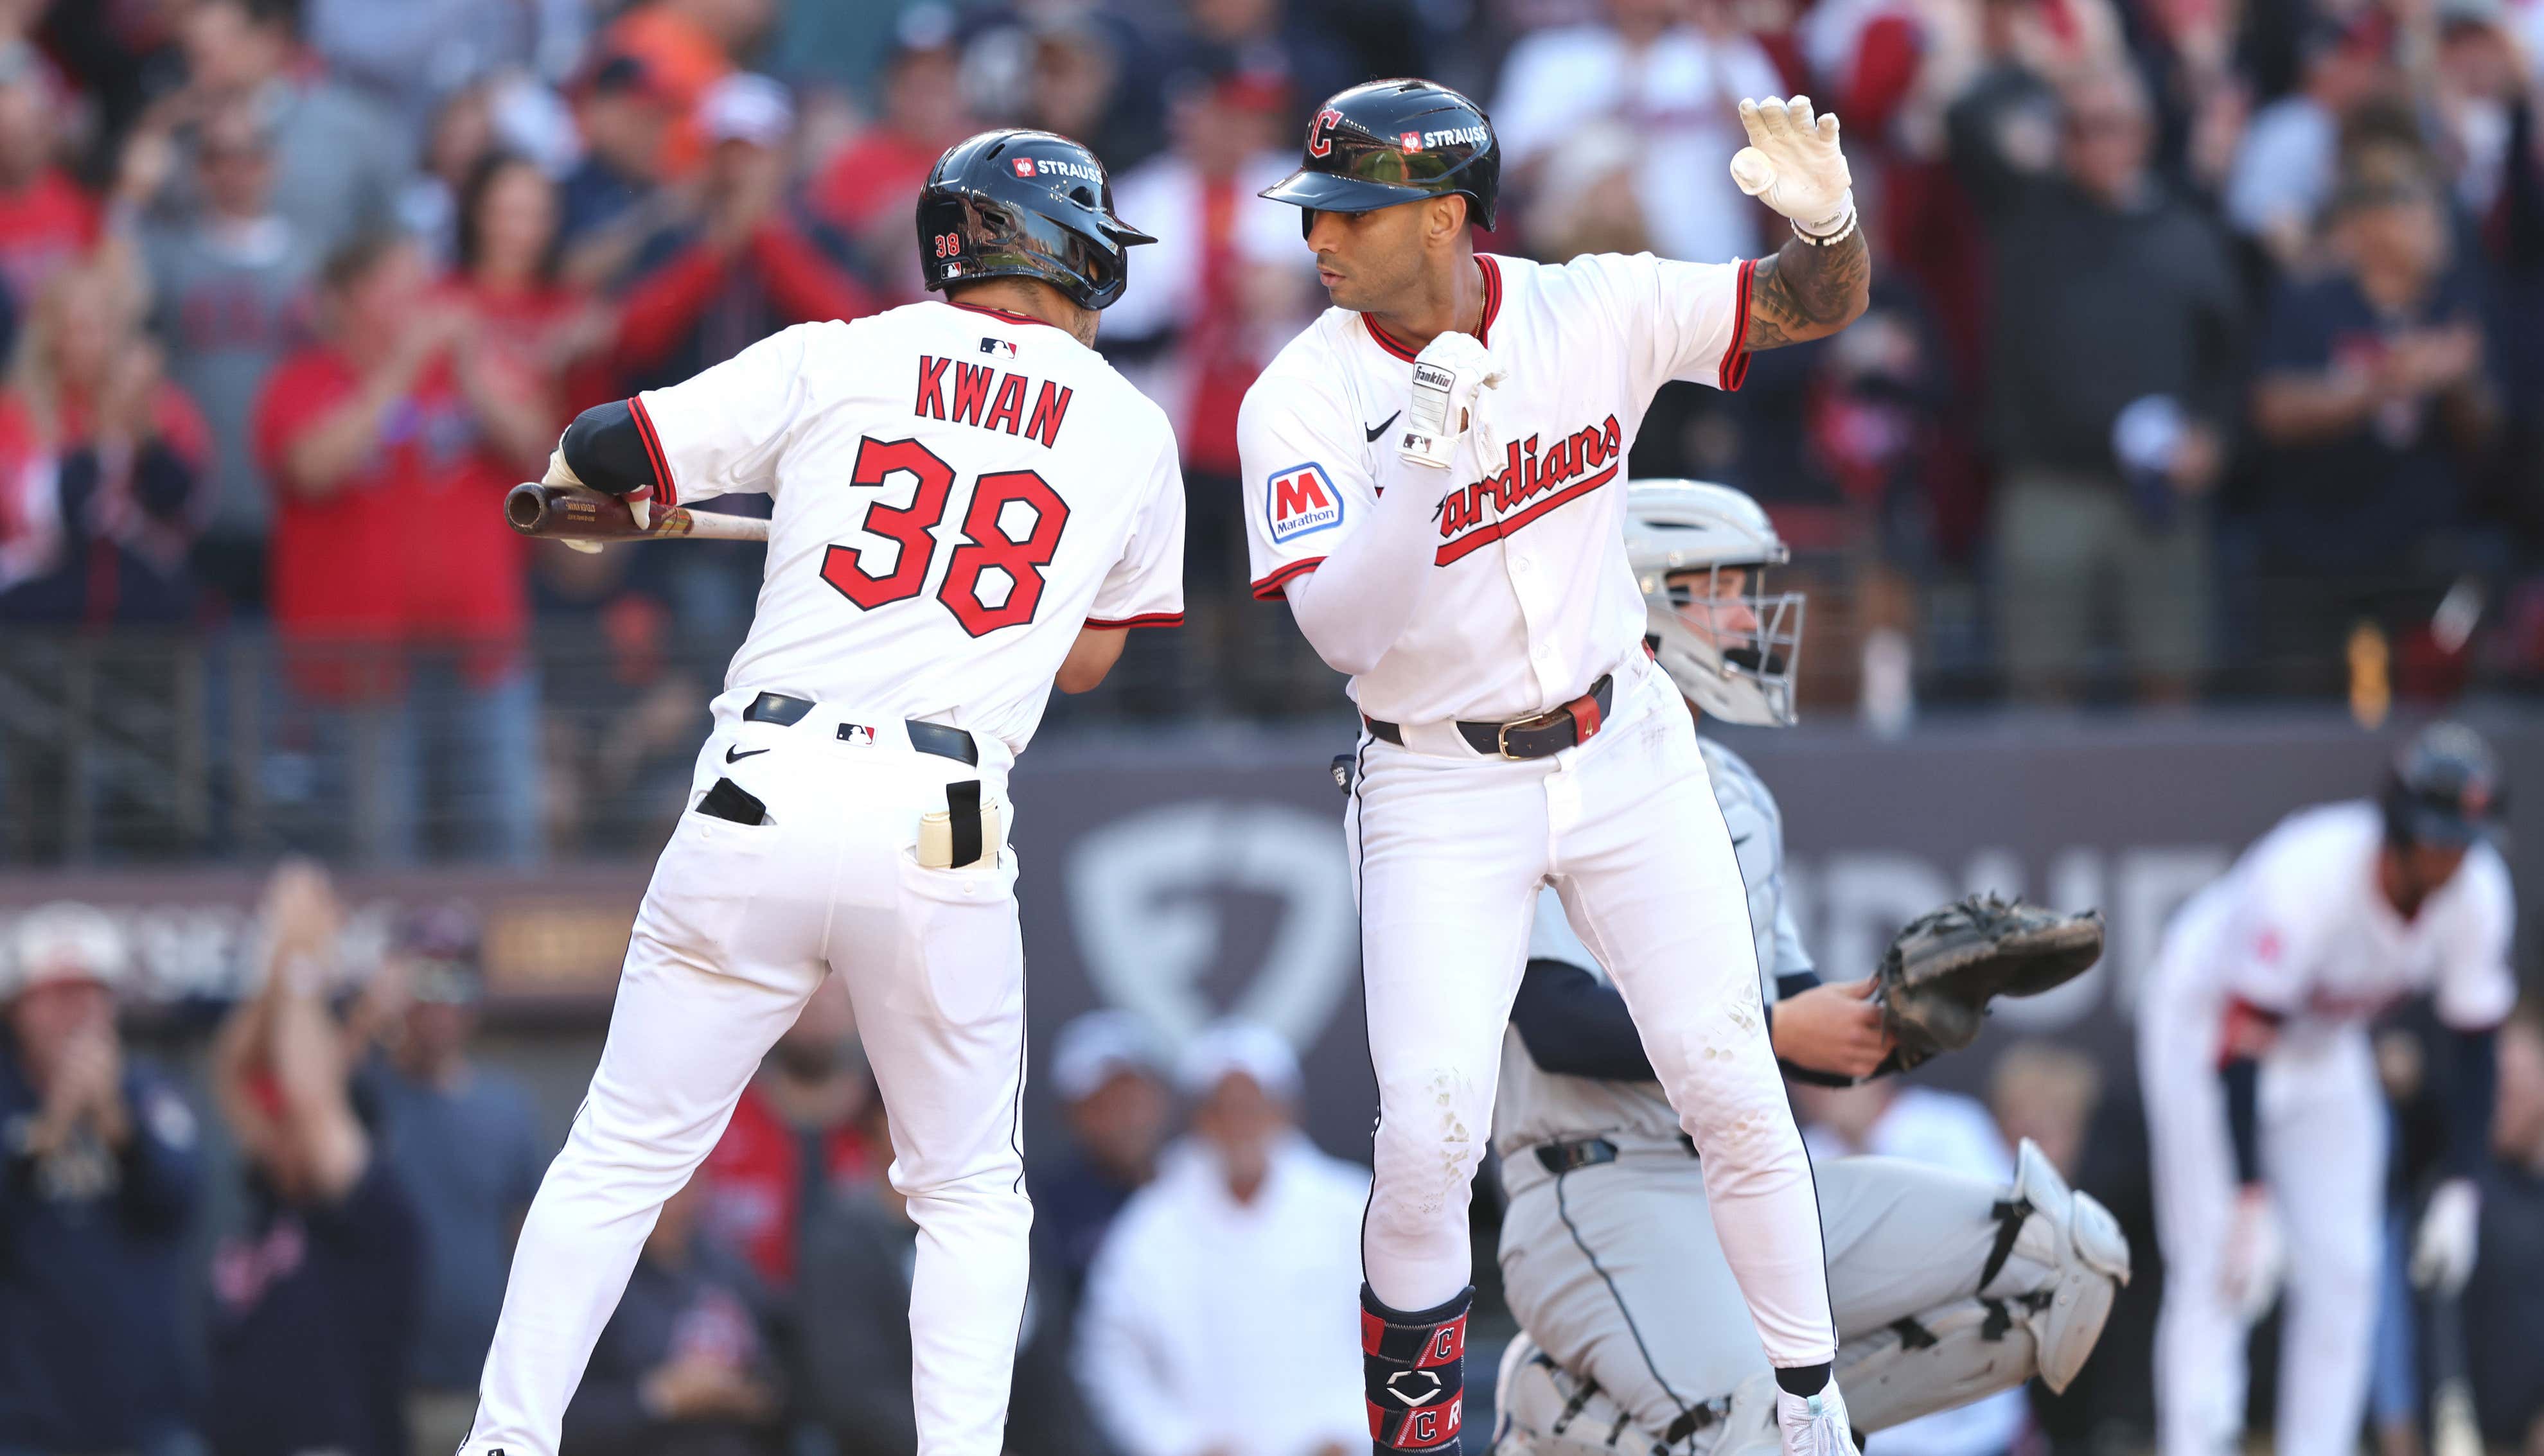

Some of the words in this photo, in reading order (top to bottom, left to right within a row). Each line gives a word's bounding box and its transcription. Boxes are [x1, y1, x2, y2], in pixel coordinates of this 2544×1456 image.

[1309, 108, 1345, 159] C
[1424, 125, 1488, 149] STRAUSS
[1036, 159, 1104, 186] STRAUSS
[935, 232, 961, 258] 38
[914, 355, 1073, 450] KWAN
[1431, 413, 1621, 539] ardians
[1276, 472, 1330, 522] M
[819, 435, 1072, 640] 38
[1277, 509, 1335, 534] Marathon
[1585, 719, 1593, 736] 4
[1435, 1327, 1454, 1360] C
[1415, 1412, 1436, 1442] C
[1447, 1395, 1464, 1430] R
